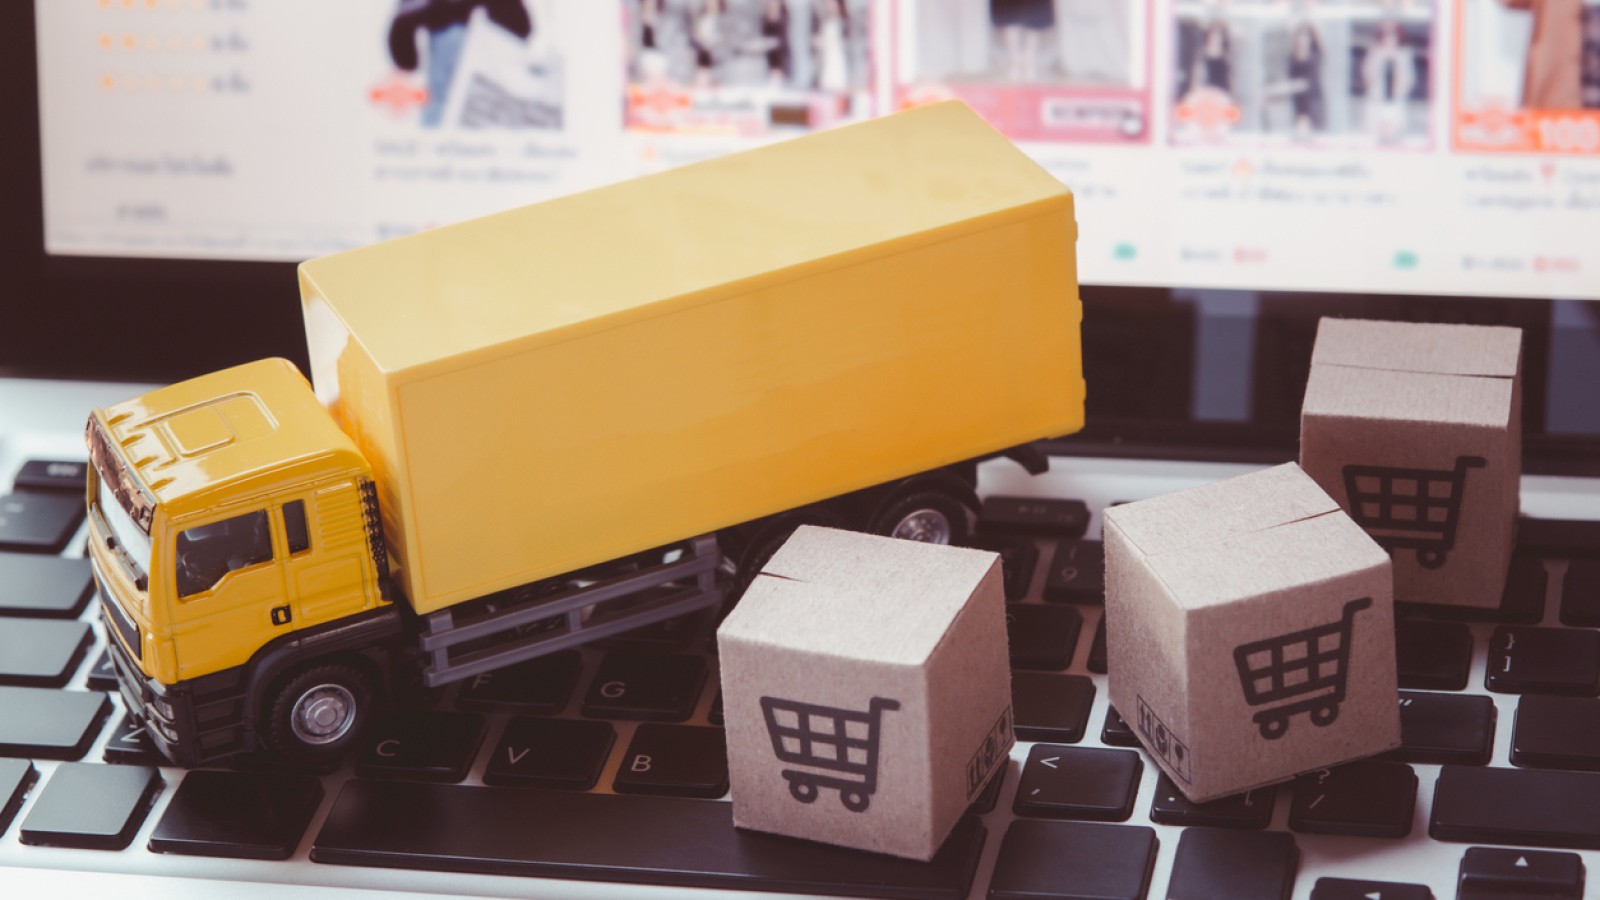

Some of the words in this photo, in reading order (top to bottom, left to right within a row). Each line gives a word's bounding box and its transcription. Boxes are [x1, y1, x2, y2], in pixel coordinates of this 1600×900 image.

[1061, 567, 1078, 582] 9
[1503, 656, 1511, 672] ]
[472, 672, 493, 689] F
[601, 681, 625, 699] G
[376, 739, 401, 757] C
[508, 746, 530, 765] V
[630, 755, 652, 772] B
[1318, 768, 1331, 785] ?
[1309, 794, 1325, 809] /
